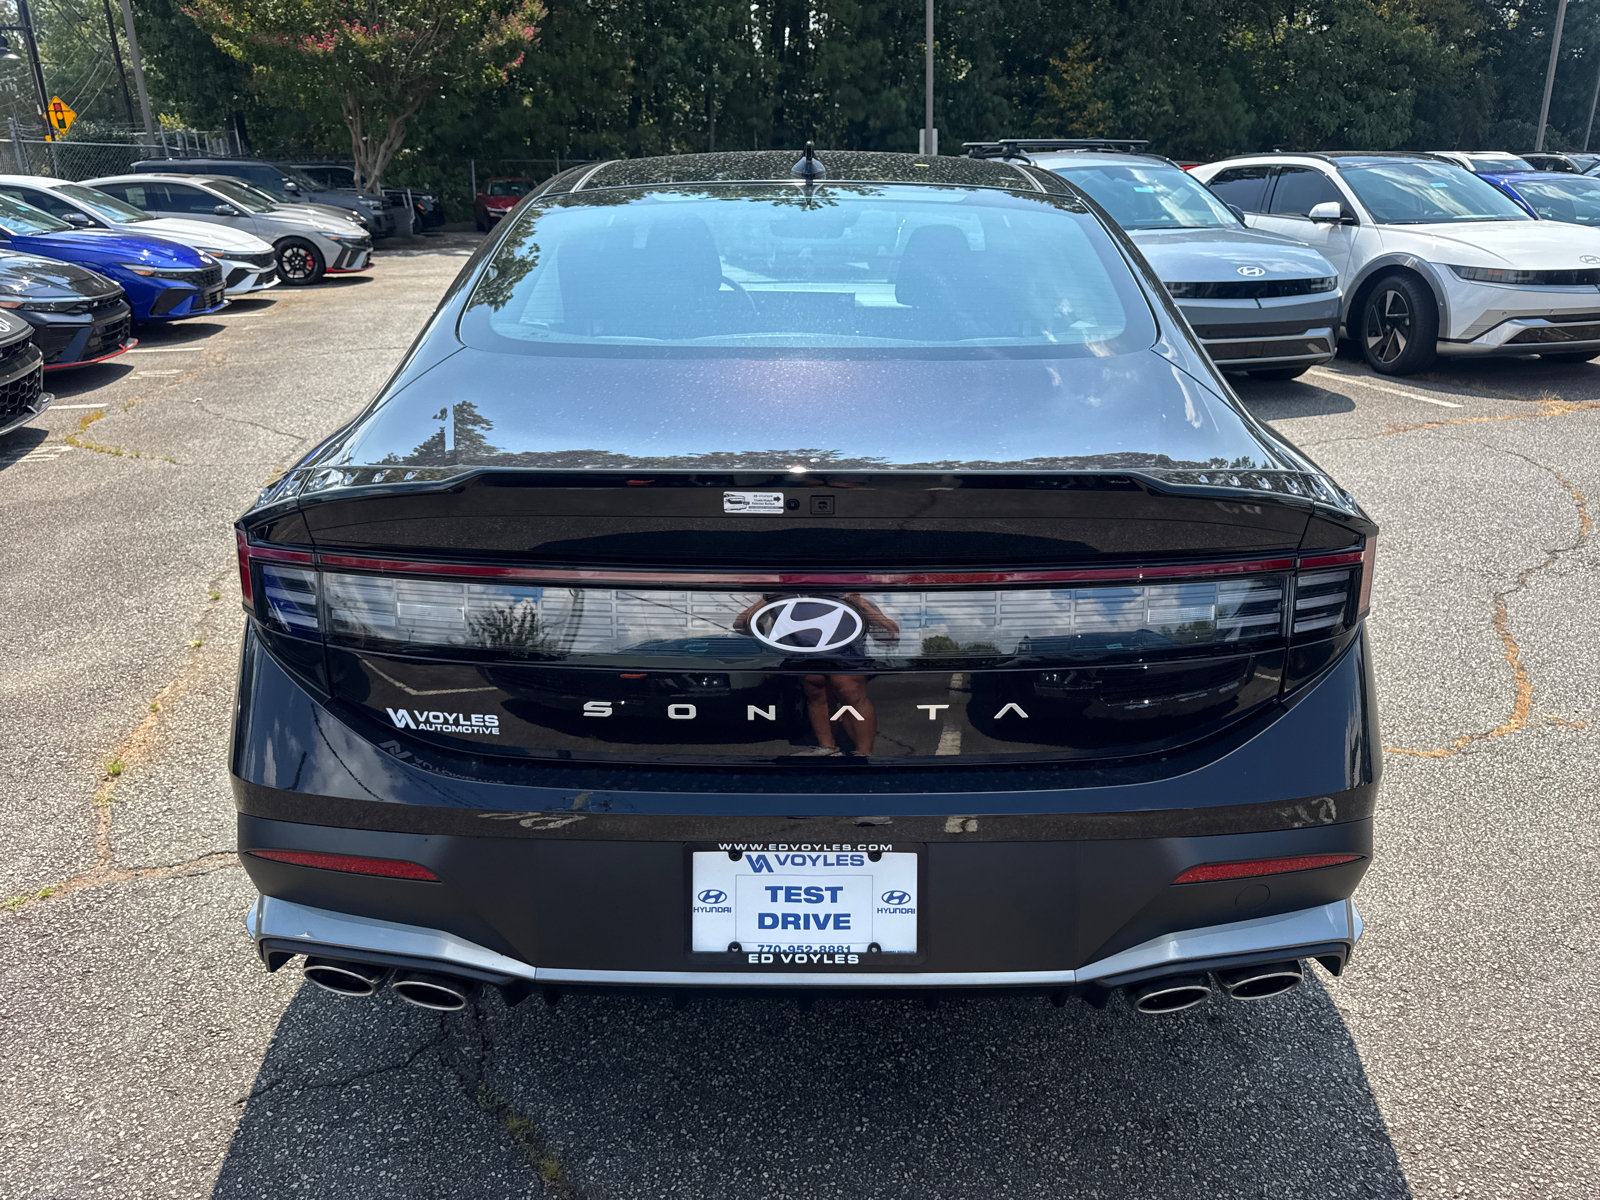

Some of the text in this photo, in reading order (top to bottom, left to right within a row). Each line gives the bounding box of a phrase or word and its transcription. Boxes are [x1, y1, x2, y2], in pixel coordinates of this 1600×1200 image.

[583, 700, 1029, 721] SONATA
[413, 710, 500, 726] VOYLES
[418, 723, 500, 735] AUTOMOTIVE
[718, 843, 893, 851] WWW.EDVOYLES.COM
[774, 854, 865, 867] VOYLES
[765, 886, 843, 903] TEST
[693, 906, 732, 914] HYUNDAI
[757, 912, 851, 930] DRIVE
[757, 944, 851, 953] 770-952-8881
[748, 954, 860, 964] ED VOYLES
